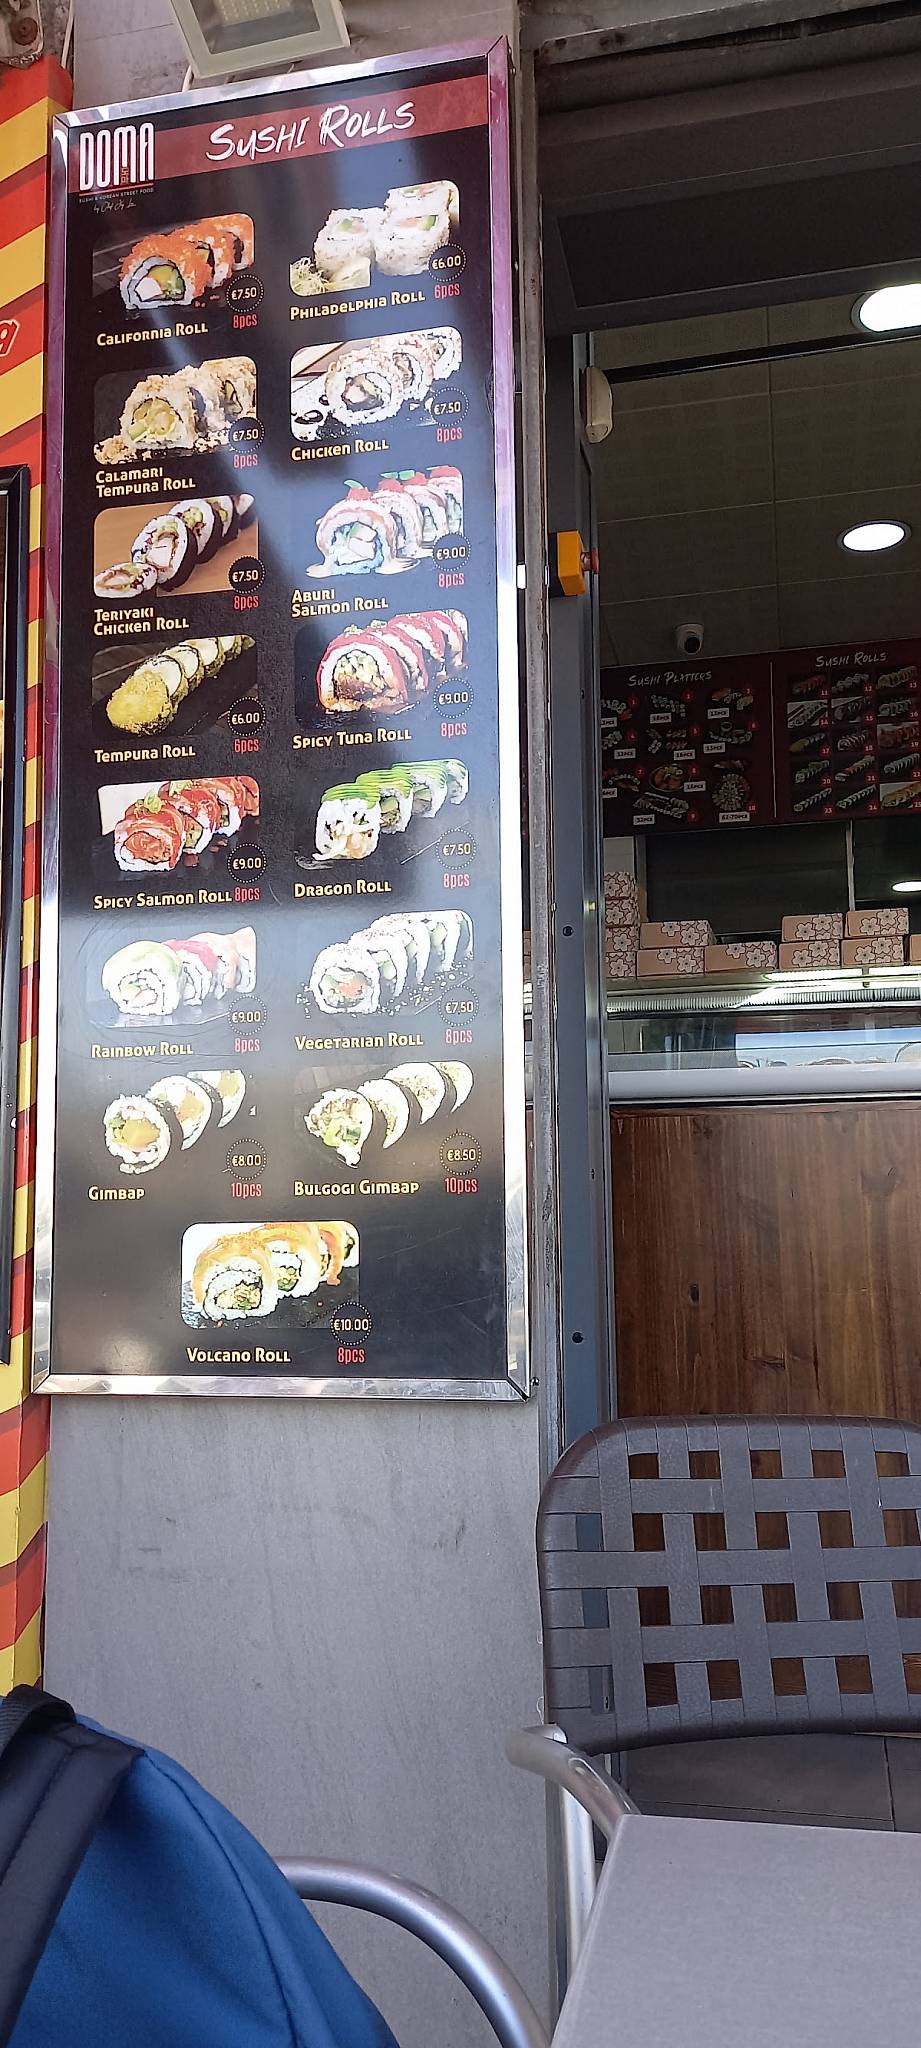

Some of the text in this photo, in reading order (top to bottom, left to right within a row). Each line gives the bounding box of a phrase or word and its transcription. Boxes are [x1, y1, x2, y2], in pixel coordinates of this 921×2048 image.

[205, 102, 415, 160] SUSHI ROLLS
[79, 122, 154, 191] DOMA
[432, 255, 461, 270] €6.00
[231, 287, 257, 300] €7.50
[434, 284, 460, 299] 6pcs
[233, 314, 258, 329] 8pcs
[434, 401, 461, 415] €7.50
[232, 428, 259, 442] €7.50
[436, 427, 463, 443] 8pcs
[233, 454, 258, 469] 8pcs
[436, 547, 466, 560] €9.00
[232, 570, 258, 583] €7.50
[438, 573, 465, 588] 8pcs
[233, 595, 259, 610] 8pcs
[815, 651, 887, 668] SUSHI ROLLS
[627, 671, 713, 687] SUSHI PLATTERS
[438, 692, 468, 705] €9.00
[232, 712, 260, 725] €6.00
[440, 723, 467, 738] 8pcs
[234, 738, 259, 753] 6pcs
[443, 843, 471, 856] €7.50
[232, 857, 262, 870] €9.00
[443, 874, 470, 889] 8pcs
[234, 887, 260, 902] 8pcs
[445, 1001, 474, 1014] €7.50
[232, 1011, 261, 1023] €9.00
[445, 1029, 472, 1045] 8pcs
[234, 1038, 260, 1053] 8pcs
[232, 1154, 262, 1167] €8.00
[447, 1149, 476, 1161] €8.50
[231, 1183, 262, 1198] 10pcs
[445, 1177, 477, 1194] 10pcs
[334, 1318, 369, 1331] €10.00
[338, 1348, 365, 1363] 8pcs
